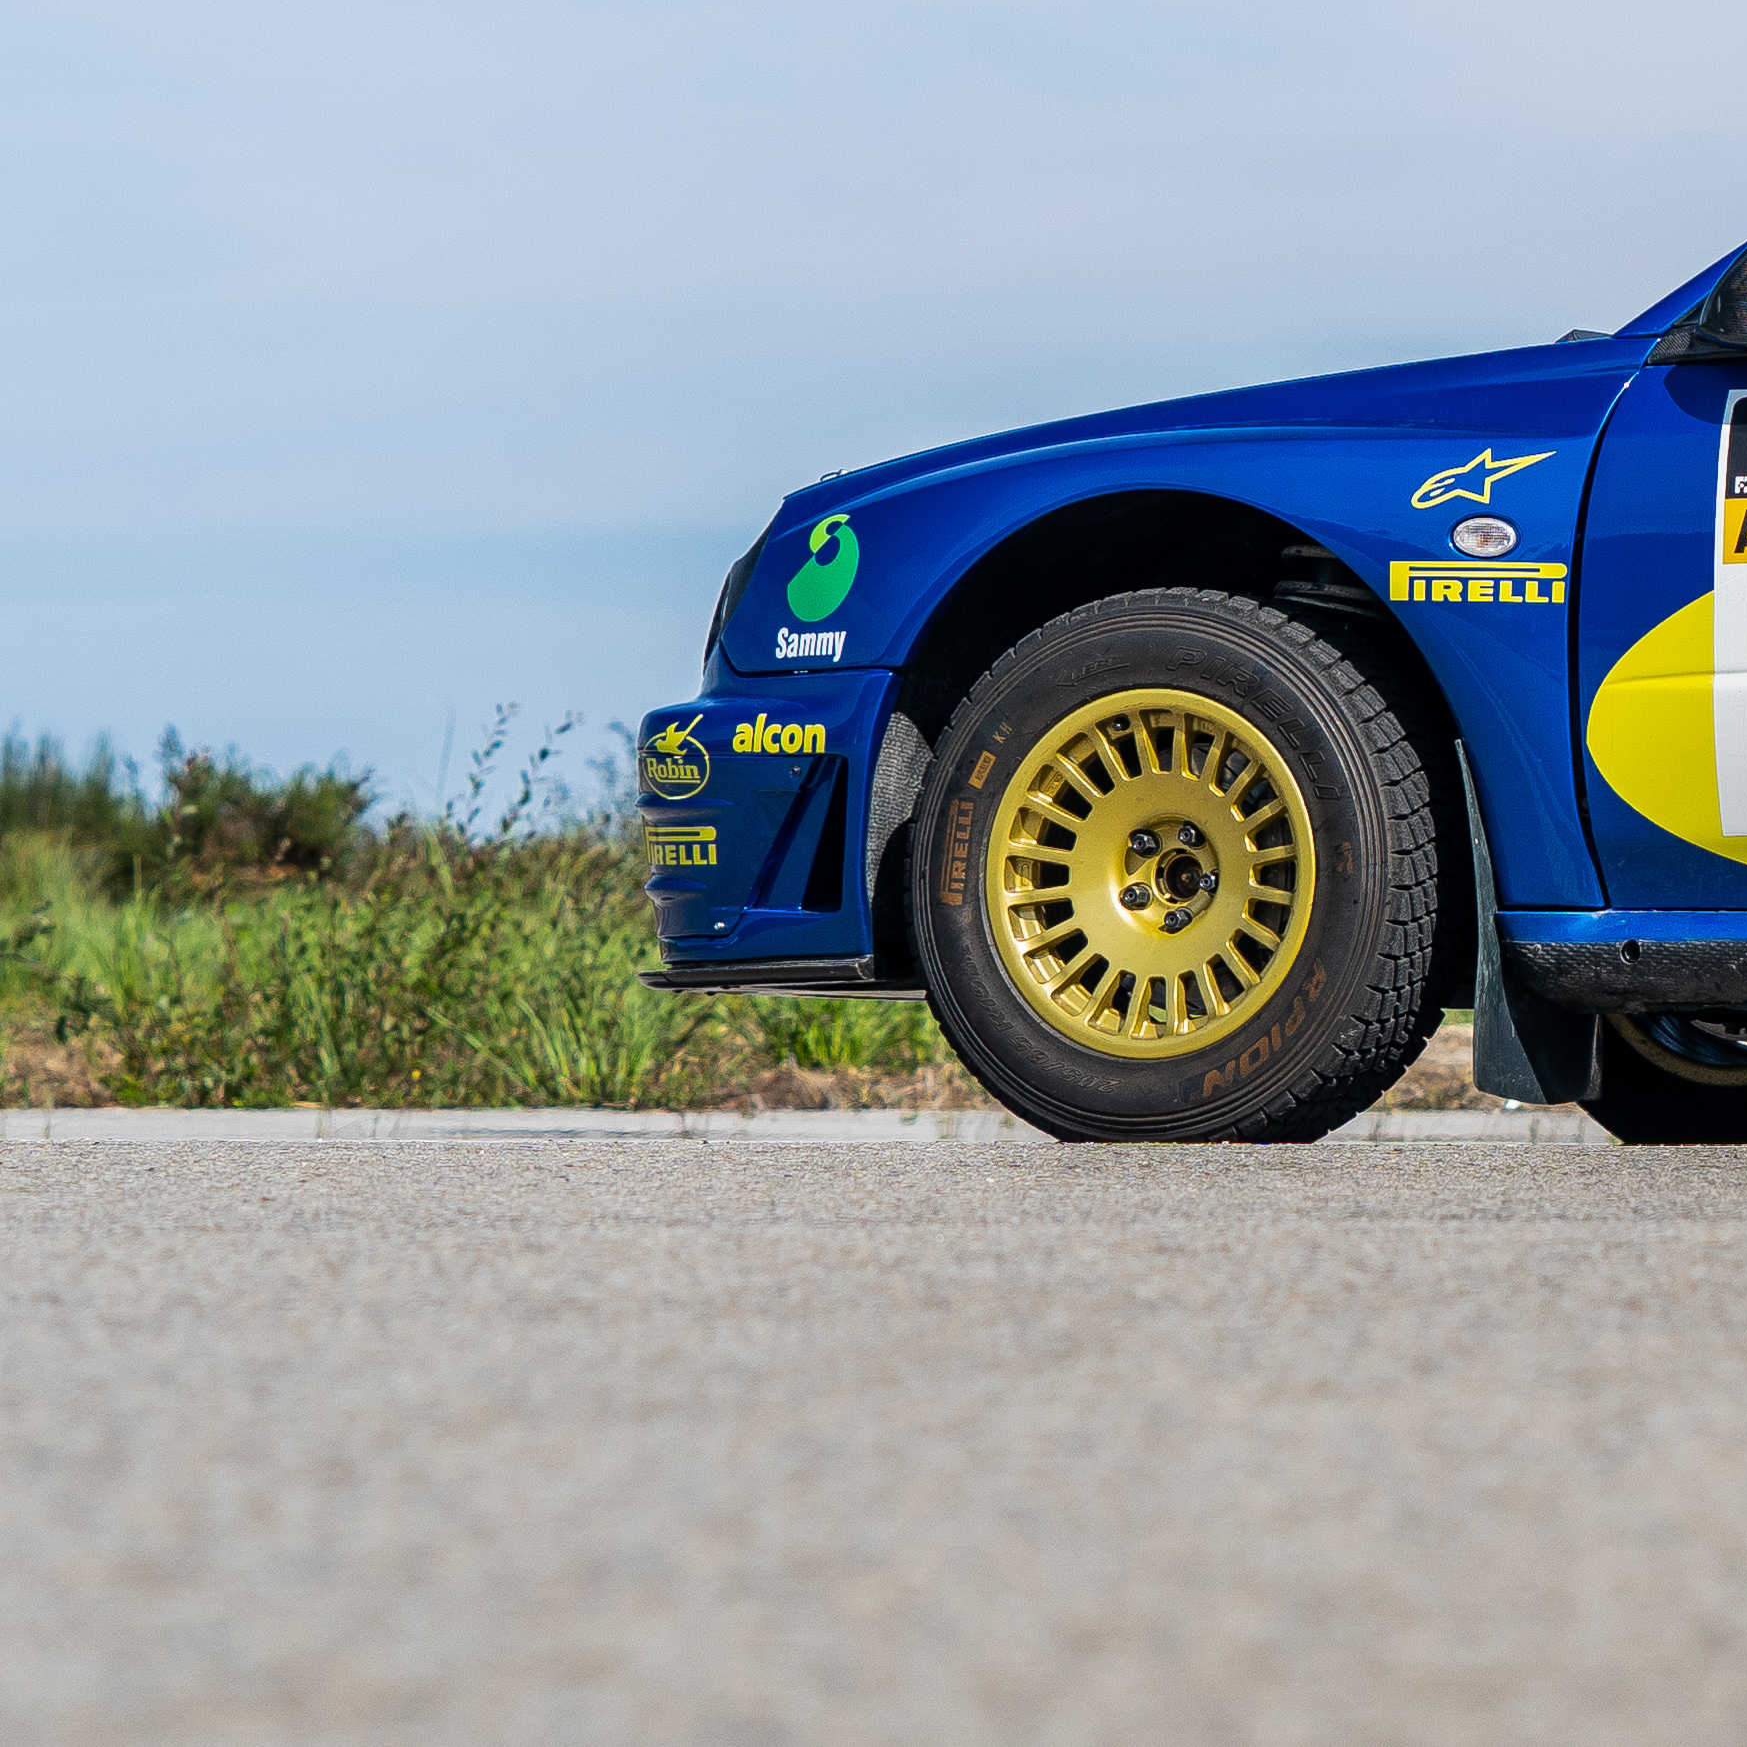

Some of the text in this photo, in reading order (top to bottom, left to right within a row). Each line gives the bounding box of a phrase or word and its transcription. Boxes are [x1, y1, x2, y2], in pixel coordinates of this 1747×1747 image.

[1390, 561, 1567, 603] PIRELLI
[776, 628, 846, 662] Sammy
[733, 713, 825, 754] alcon
[1165, 645, 1340, 800] PIRELLI
[647, 757, 700, 783] Robin
[645, 826, 717, 865] PIRELLI
[939, 798, 975, 907] PIRELLI
